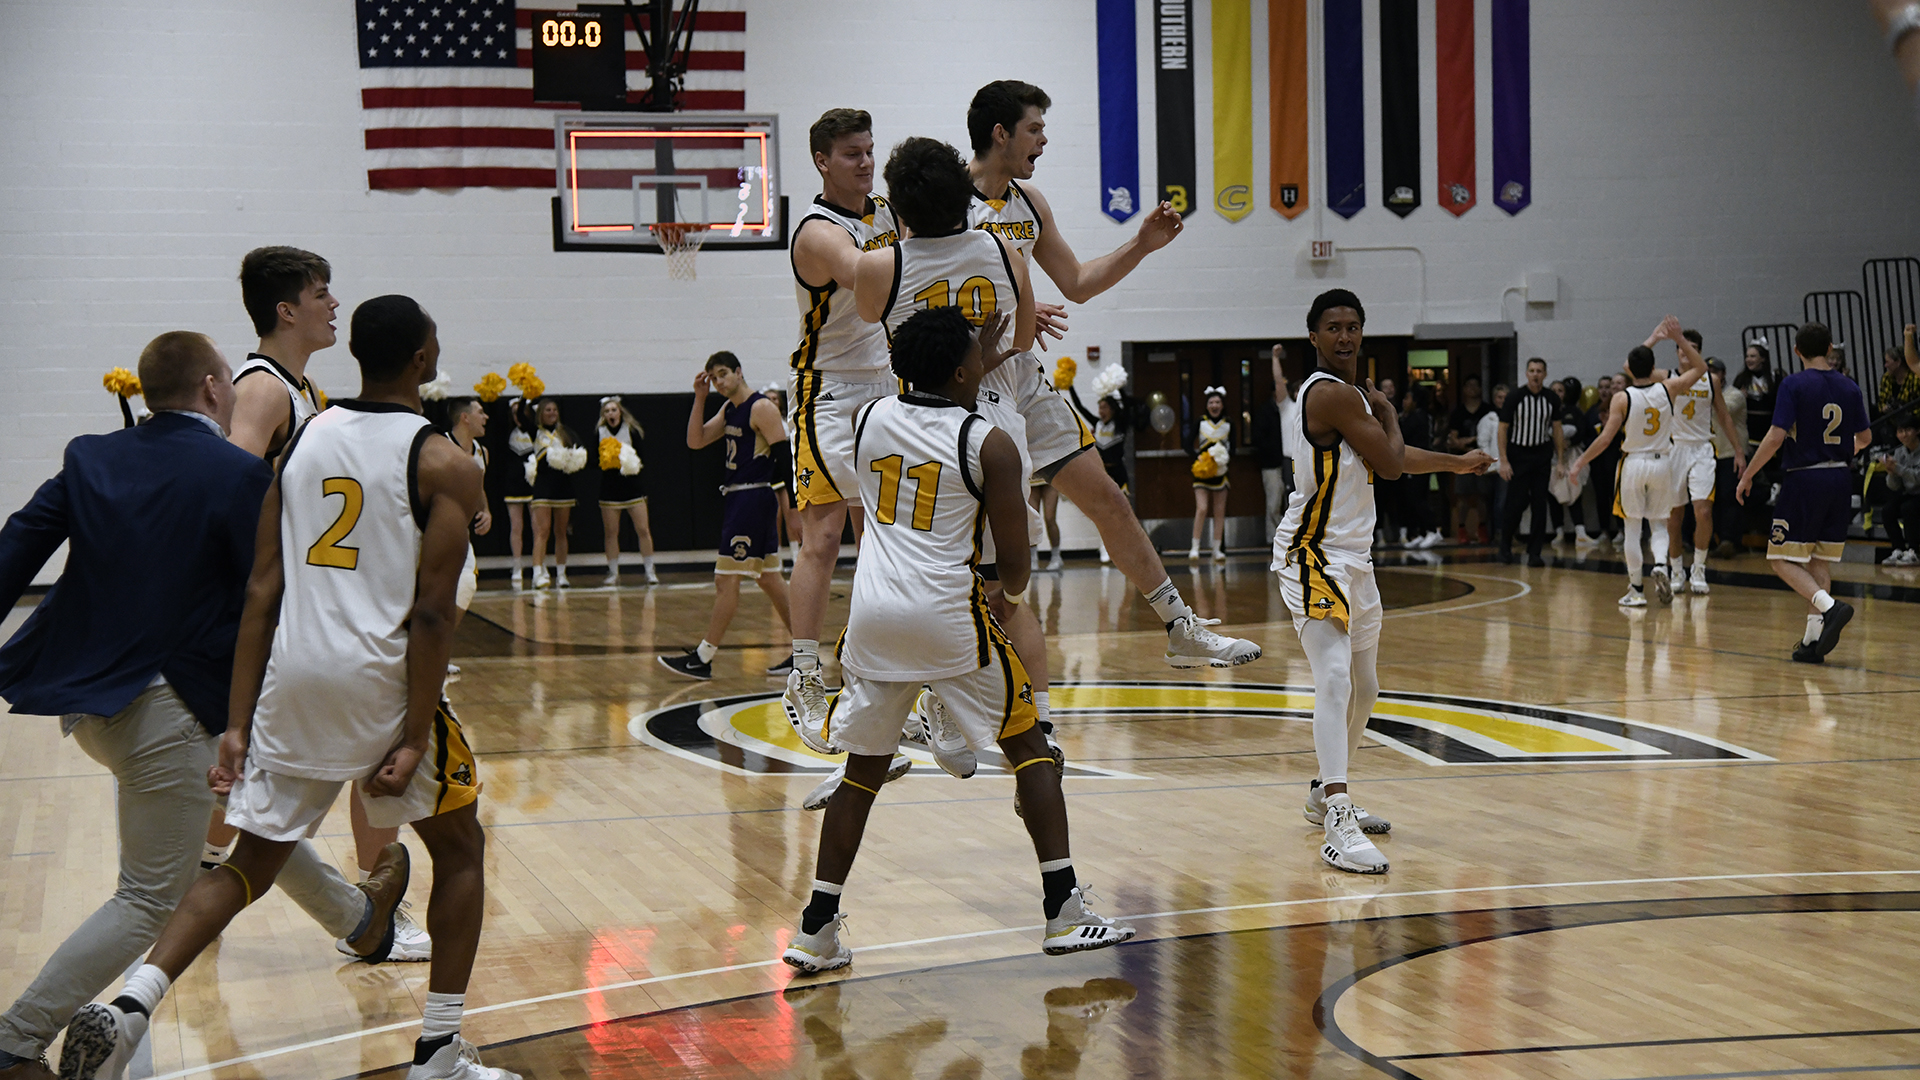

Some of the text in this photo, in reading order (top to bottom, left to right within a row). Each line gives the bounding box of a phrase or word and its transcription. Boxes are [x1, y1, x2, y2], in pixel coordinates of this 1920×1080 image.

[542, 20, 601, 48] 00.0
[1217, 184, 1249, 211] C
[1283, 189, 1295, 203] H
[1312, 241, 1332, 257] EXIT
[1643, 407, 1661, 436] 3
[1682, 400, 1696, 420] 4
[1822, 402, 1843, 445] 2
[870, 454, 942, 532] 11
[305, 476, 364, 571] 2
